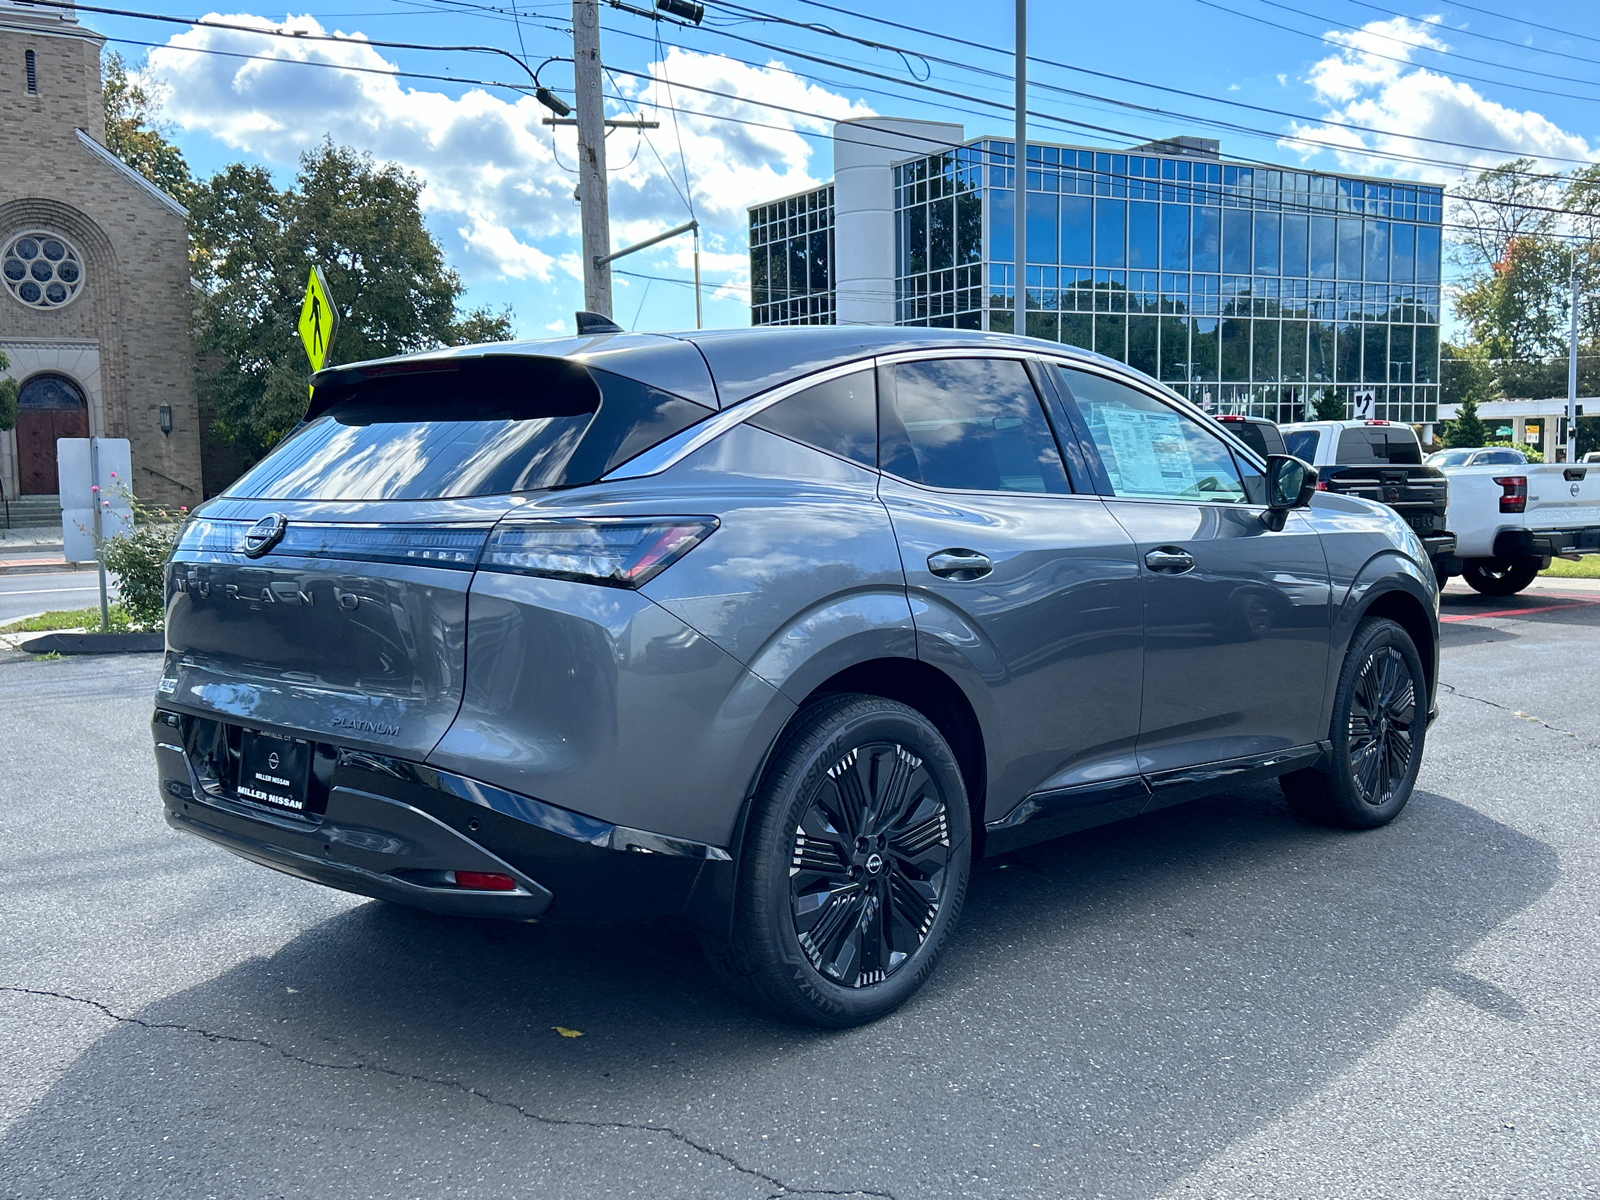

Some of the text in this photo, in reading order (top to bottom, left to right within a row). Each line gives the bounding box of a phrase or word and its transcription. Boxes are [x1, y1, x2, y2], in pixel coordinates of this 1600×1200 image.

[1534, 508, 1600, 520] FRONTIE
[332, 717, 400, 736] PLATINUM
[255, 772, 290, 787] MILLER NISSAN
[237, 785, 303, 810] MILLER NISSAN
